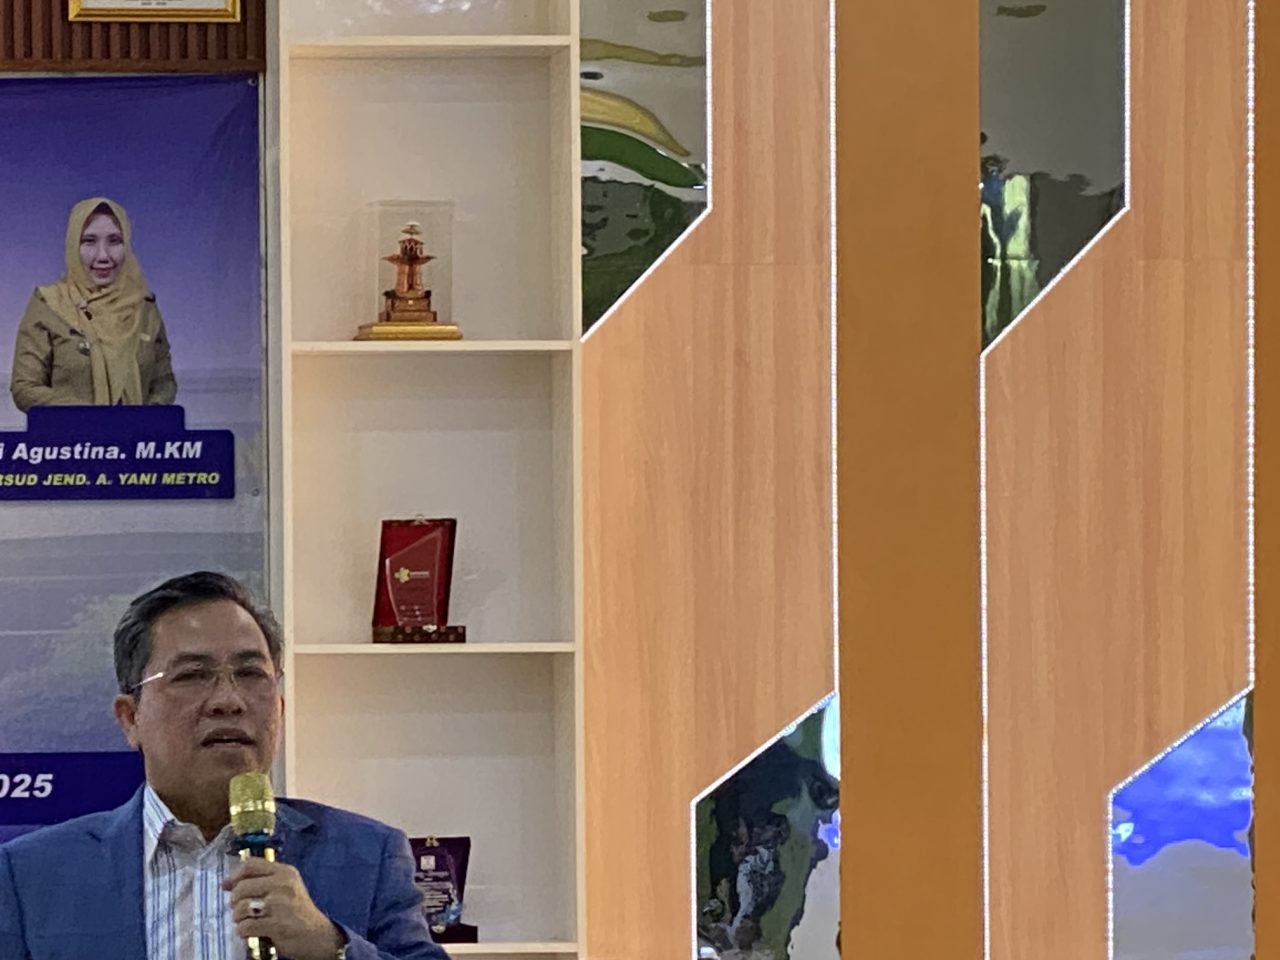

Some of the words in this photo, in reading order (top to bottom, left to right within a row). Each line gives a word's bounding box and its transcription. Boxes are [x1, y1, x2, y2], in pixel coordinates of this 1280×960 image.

[135, 440, 203, 460] M.KM
[43, 473, 91, 486] JEND.
[96, 473, 113, 486] A.
[118, 472, 157, 486] YANI
[162, 472, 220, 485] METRO
